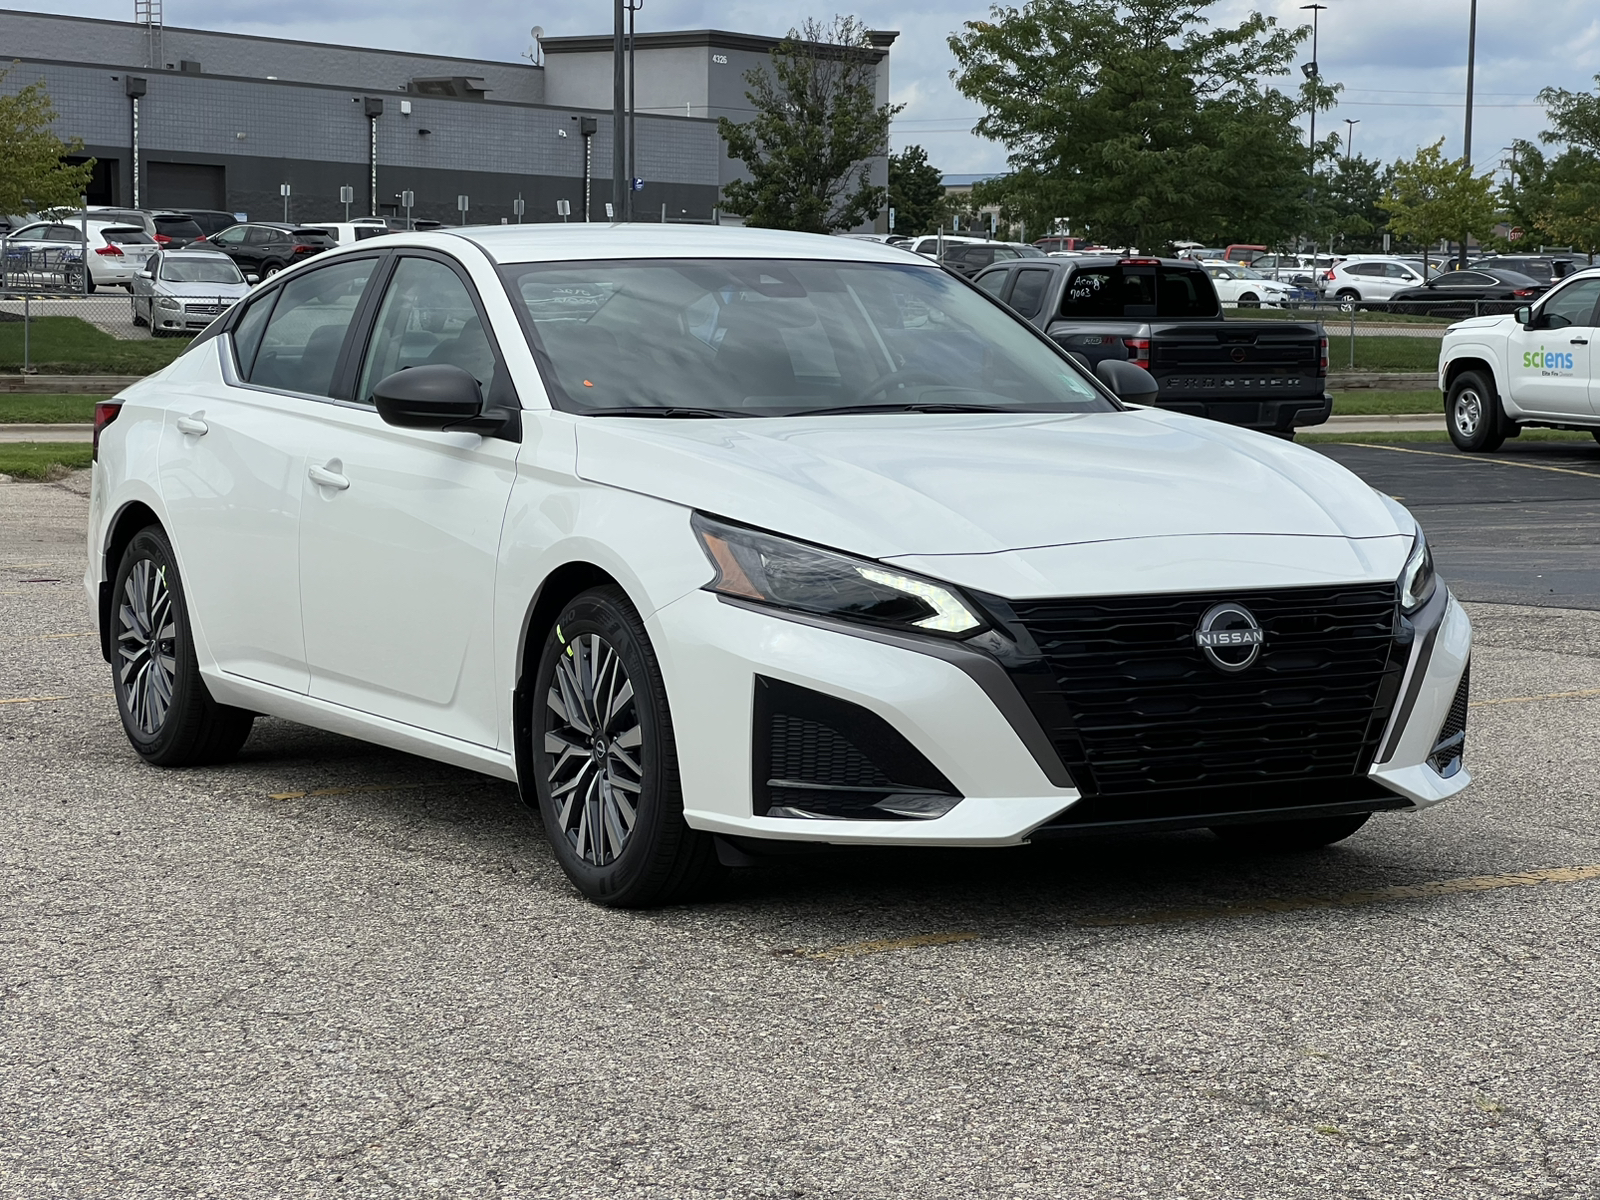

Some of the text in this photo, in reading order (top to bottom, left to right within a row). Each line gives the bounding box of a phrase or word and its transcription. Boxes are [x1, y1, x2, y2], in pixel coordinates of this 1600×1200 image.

[1523, 345, 1573, 370] sciens
[1166, 377, 1302, 389] FRONTIER
[1198, 631, 1263, 645] NISSAN
